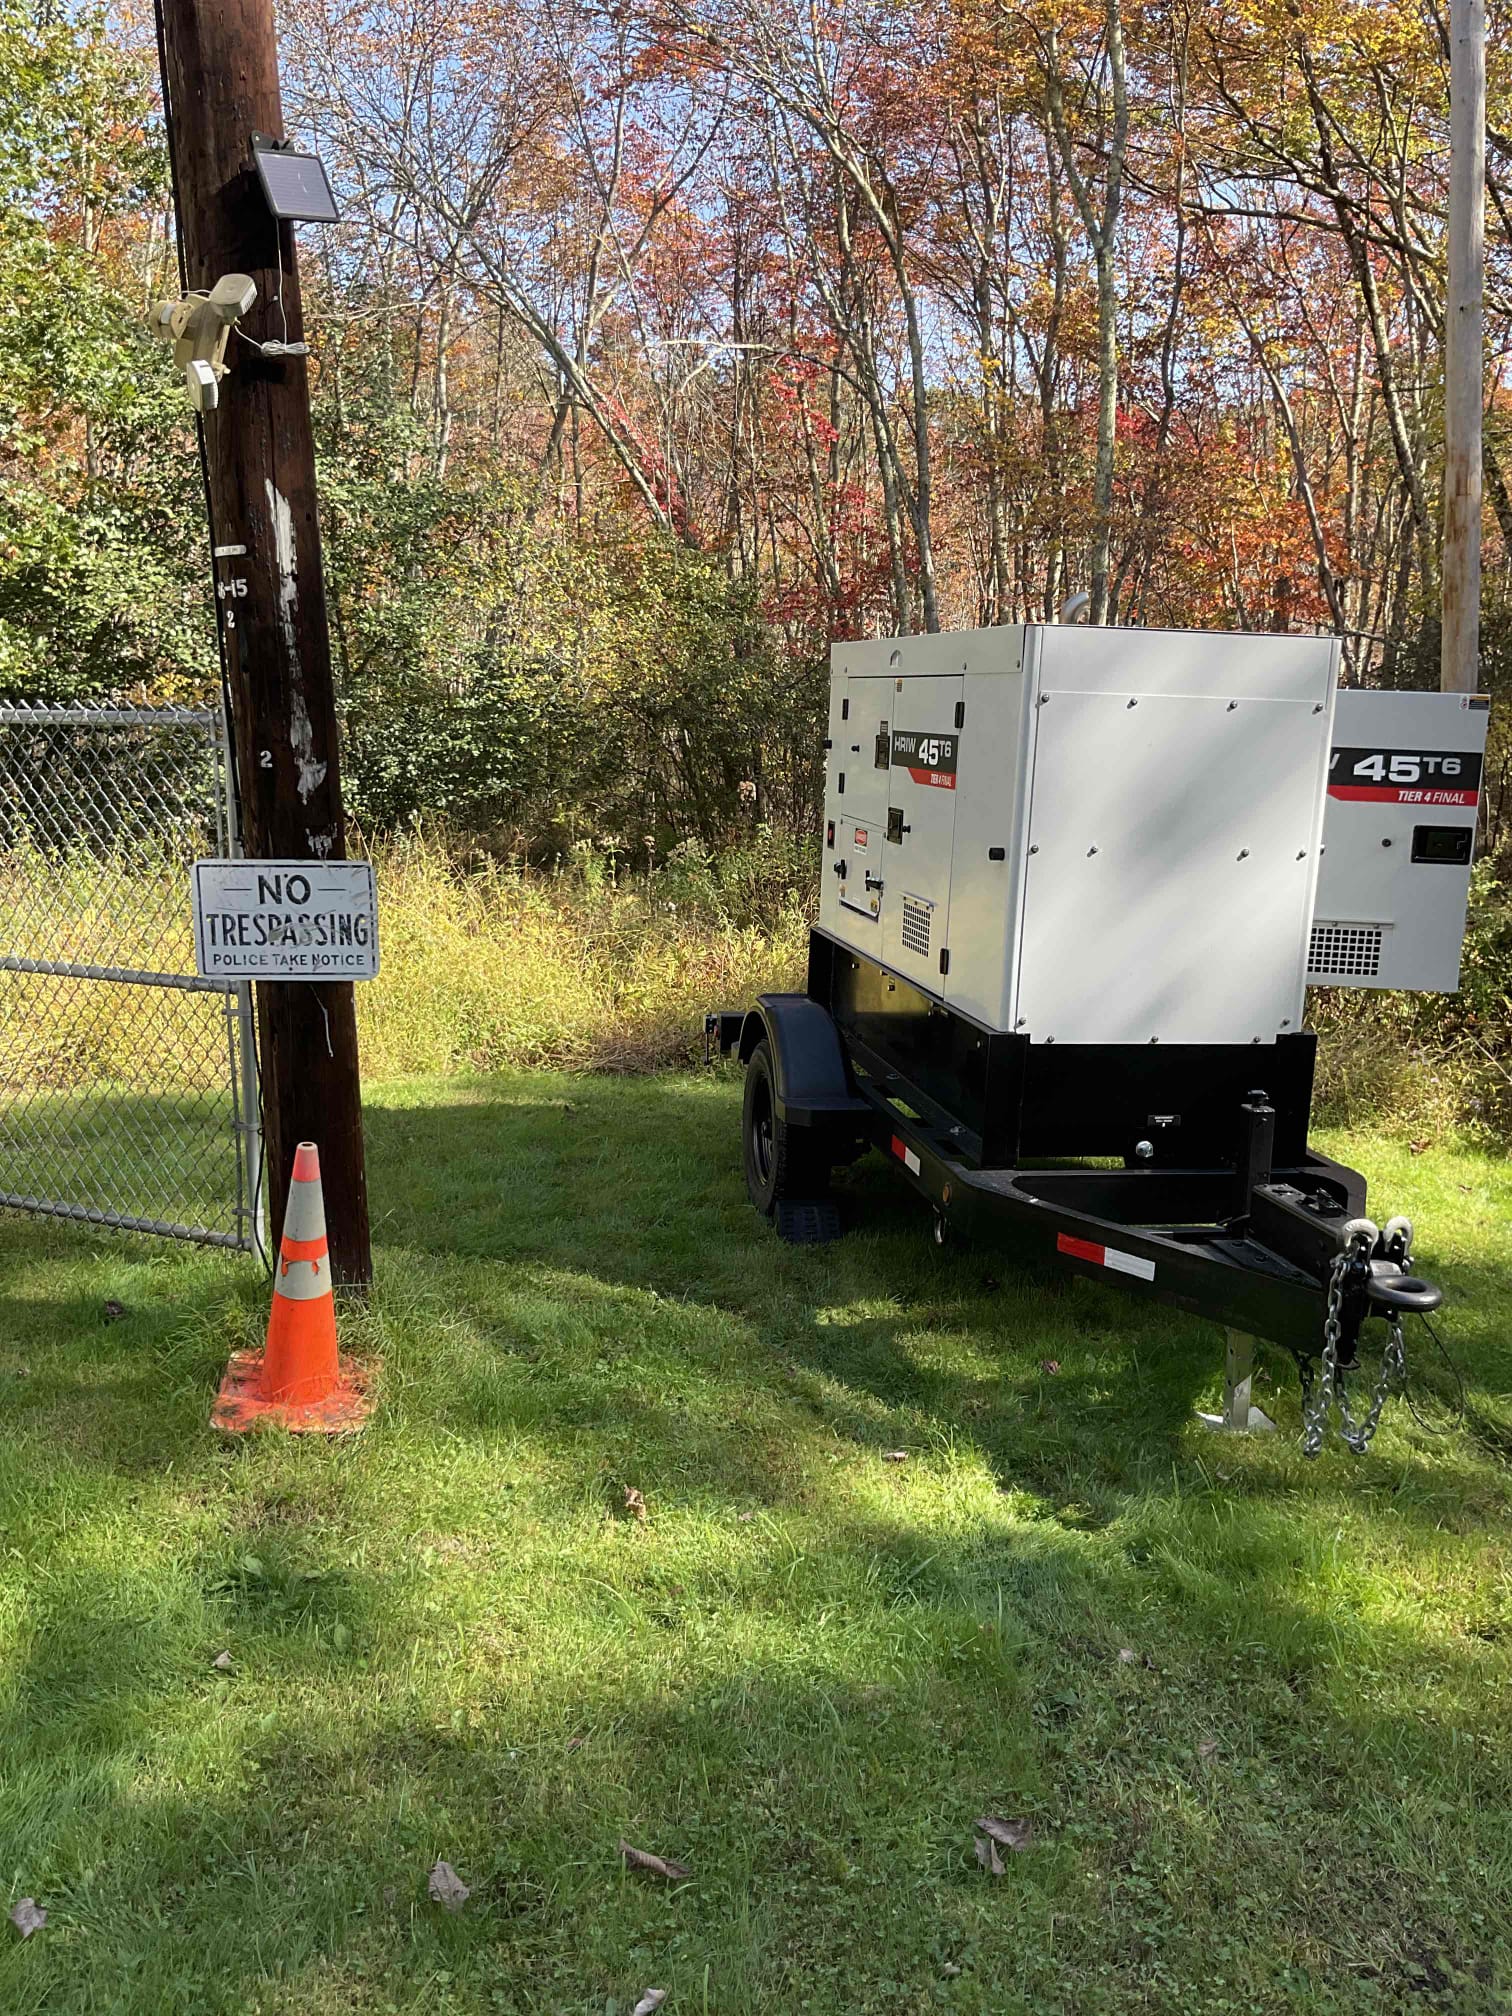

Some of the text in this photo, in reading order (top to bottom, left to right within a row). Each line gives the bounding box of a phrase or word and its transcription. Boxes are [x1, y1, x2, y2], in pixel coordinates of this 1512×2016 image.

[226, 610, 236, 629] 2
[260, 750, 273, 768] 2
[1398, 790, 1465, 804] TIER 4 FINAL
[257, 874, 311, 905] NO
[206, 913, 369, 947] TRESPASSING
[213, 953, 365, 968] POLICE TAKE NOTICE
